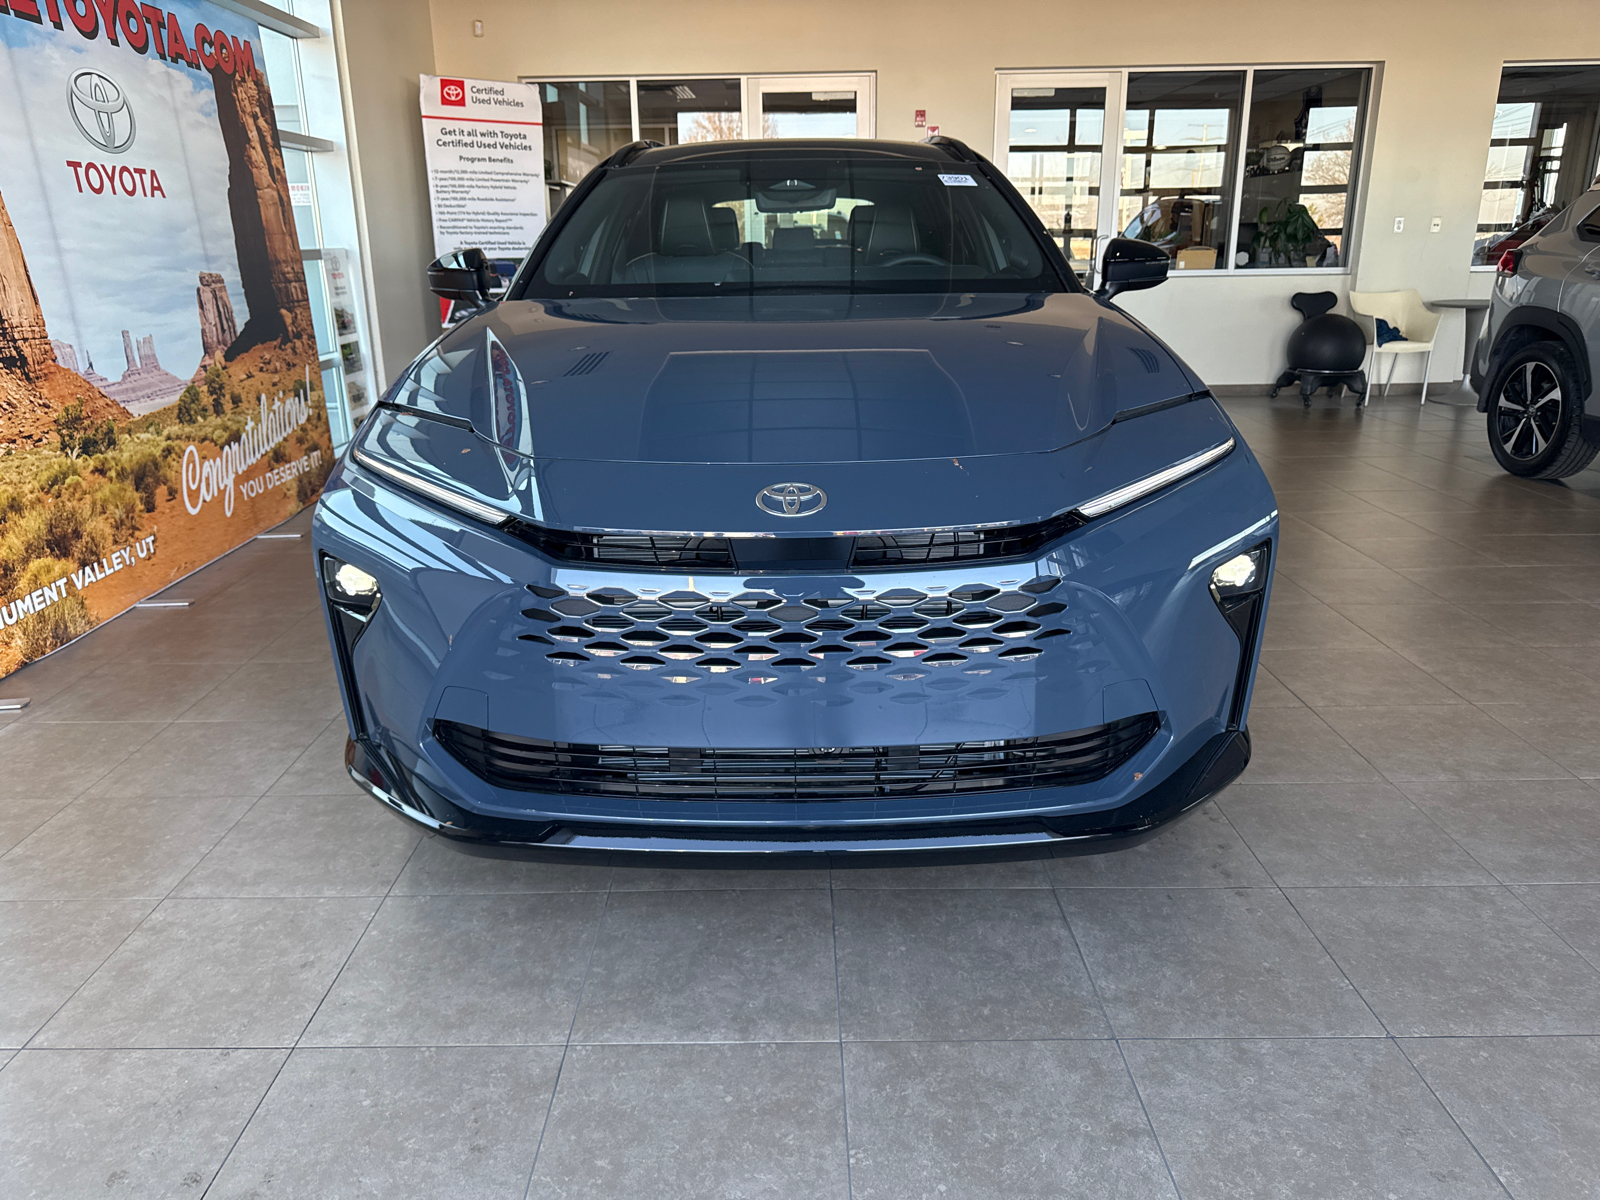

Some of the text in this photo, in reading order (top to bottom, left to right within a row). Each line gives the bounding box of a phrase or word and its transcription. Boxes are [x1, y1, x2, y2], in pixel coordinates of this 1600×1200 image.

[470, 85, 505, 96] Certified
[471, 96, 524, 108] Used Vehicles
[440, 127, 527, 142] Get it all with Toyota
[436, 138, 532, 152] Certified Used Vehicles
[459, 155, 514, 165] Program Benefits
[66, 160, 167, 199] TOYOTA
[182, 364, 313, 518] Congratulations!
[239, 450, 323, 501] YOU DESERVE IT!
[70, 546, 136, 591] VALLEY,
[135, 535, 155, 559] UT
